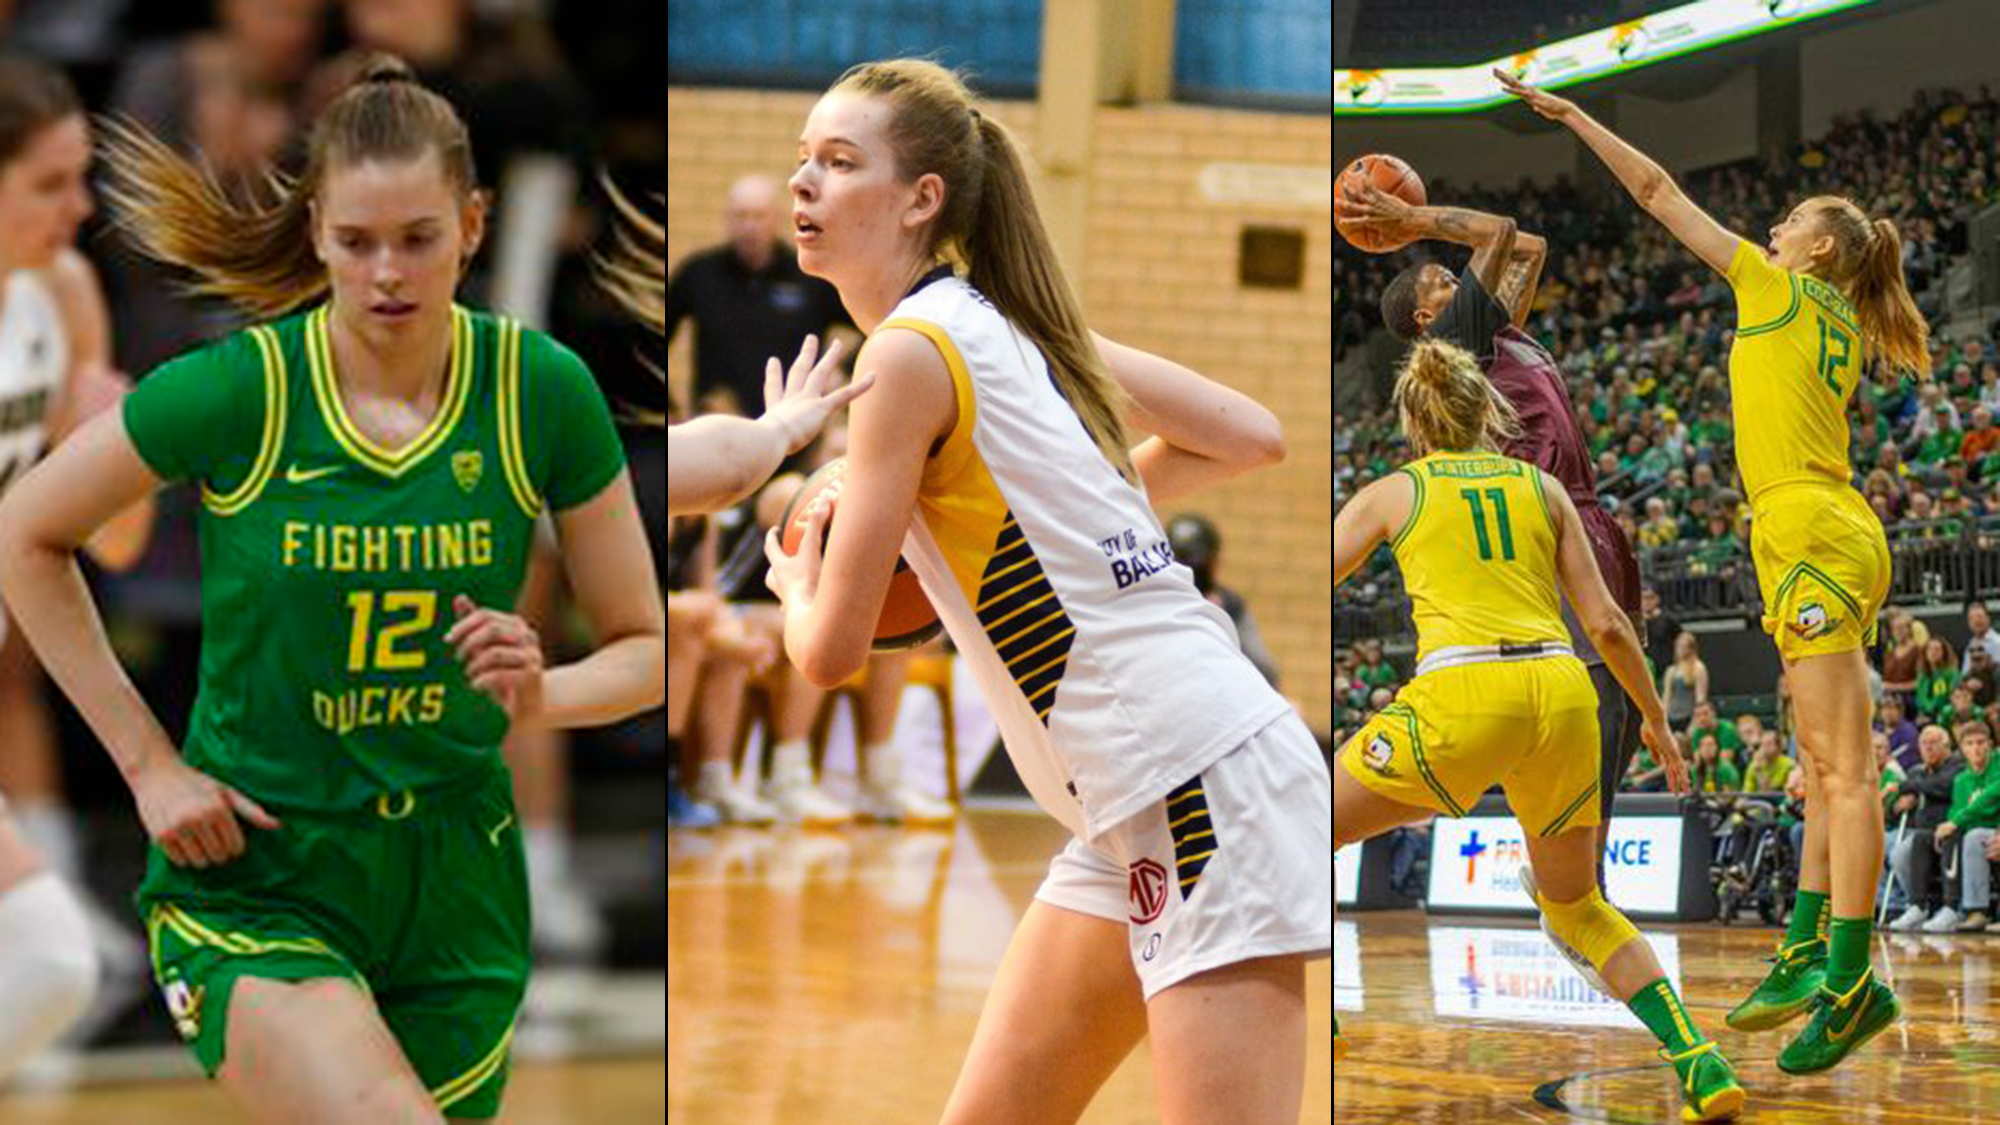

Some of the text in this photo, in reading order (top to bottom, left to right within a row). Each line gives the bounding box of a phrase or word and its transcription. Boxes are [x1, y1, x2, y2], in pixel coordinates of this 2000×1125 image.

[1817, 312, 1851, 396] 12
[282, 519, 492, 572] FIGHTING
[1460, 487, 1516, 561] 11
[346, 590, 438, 673] 12
[312, 684, 446, 735] DUCKS
